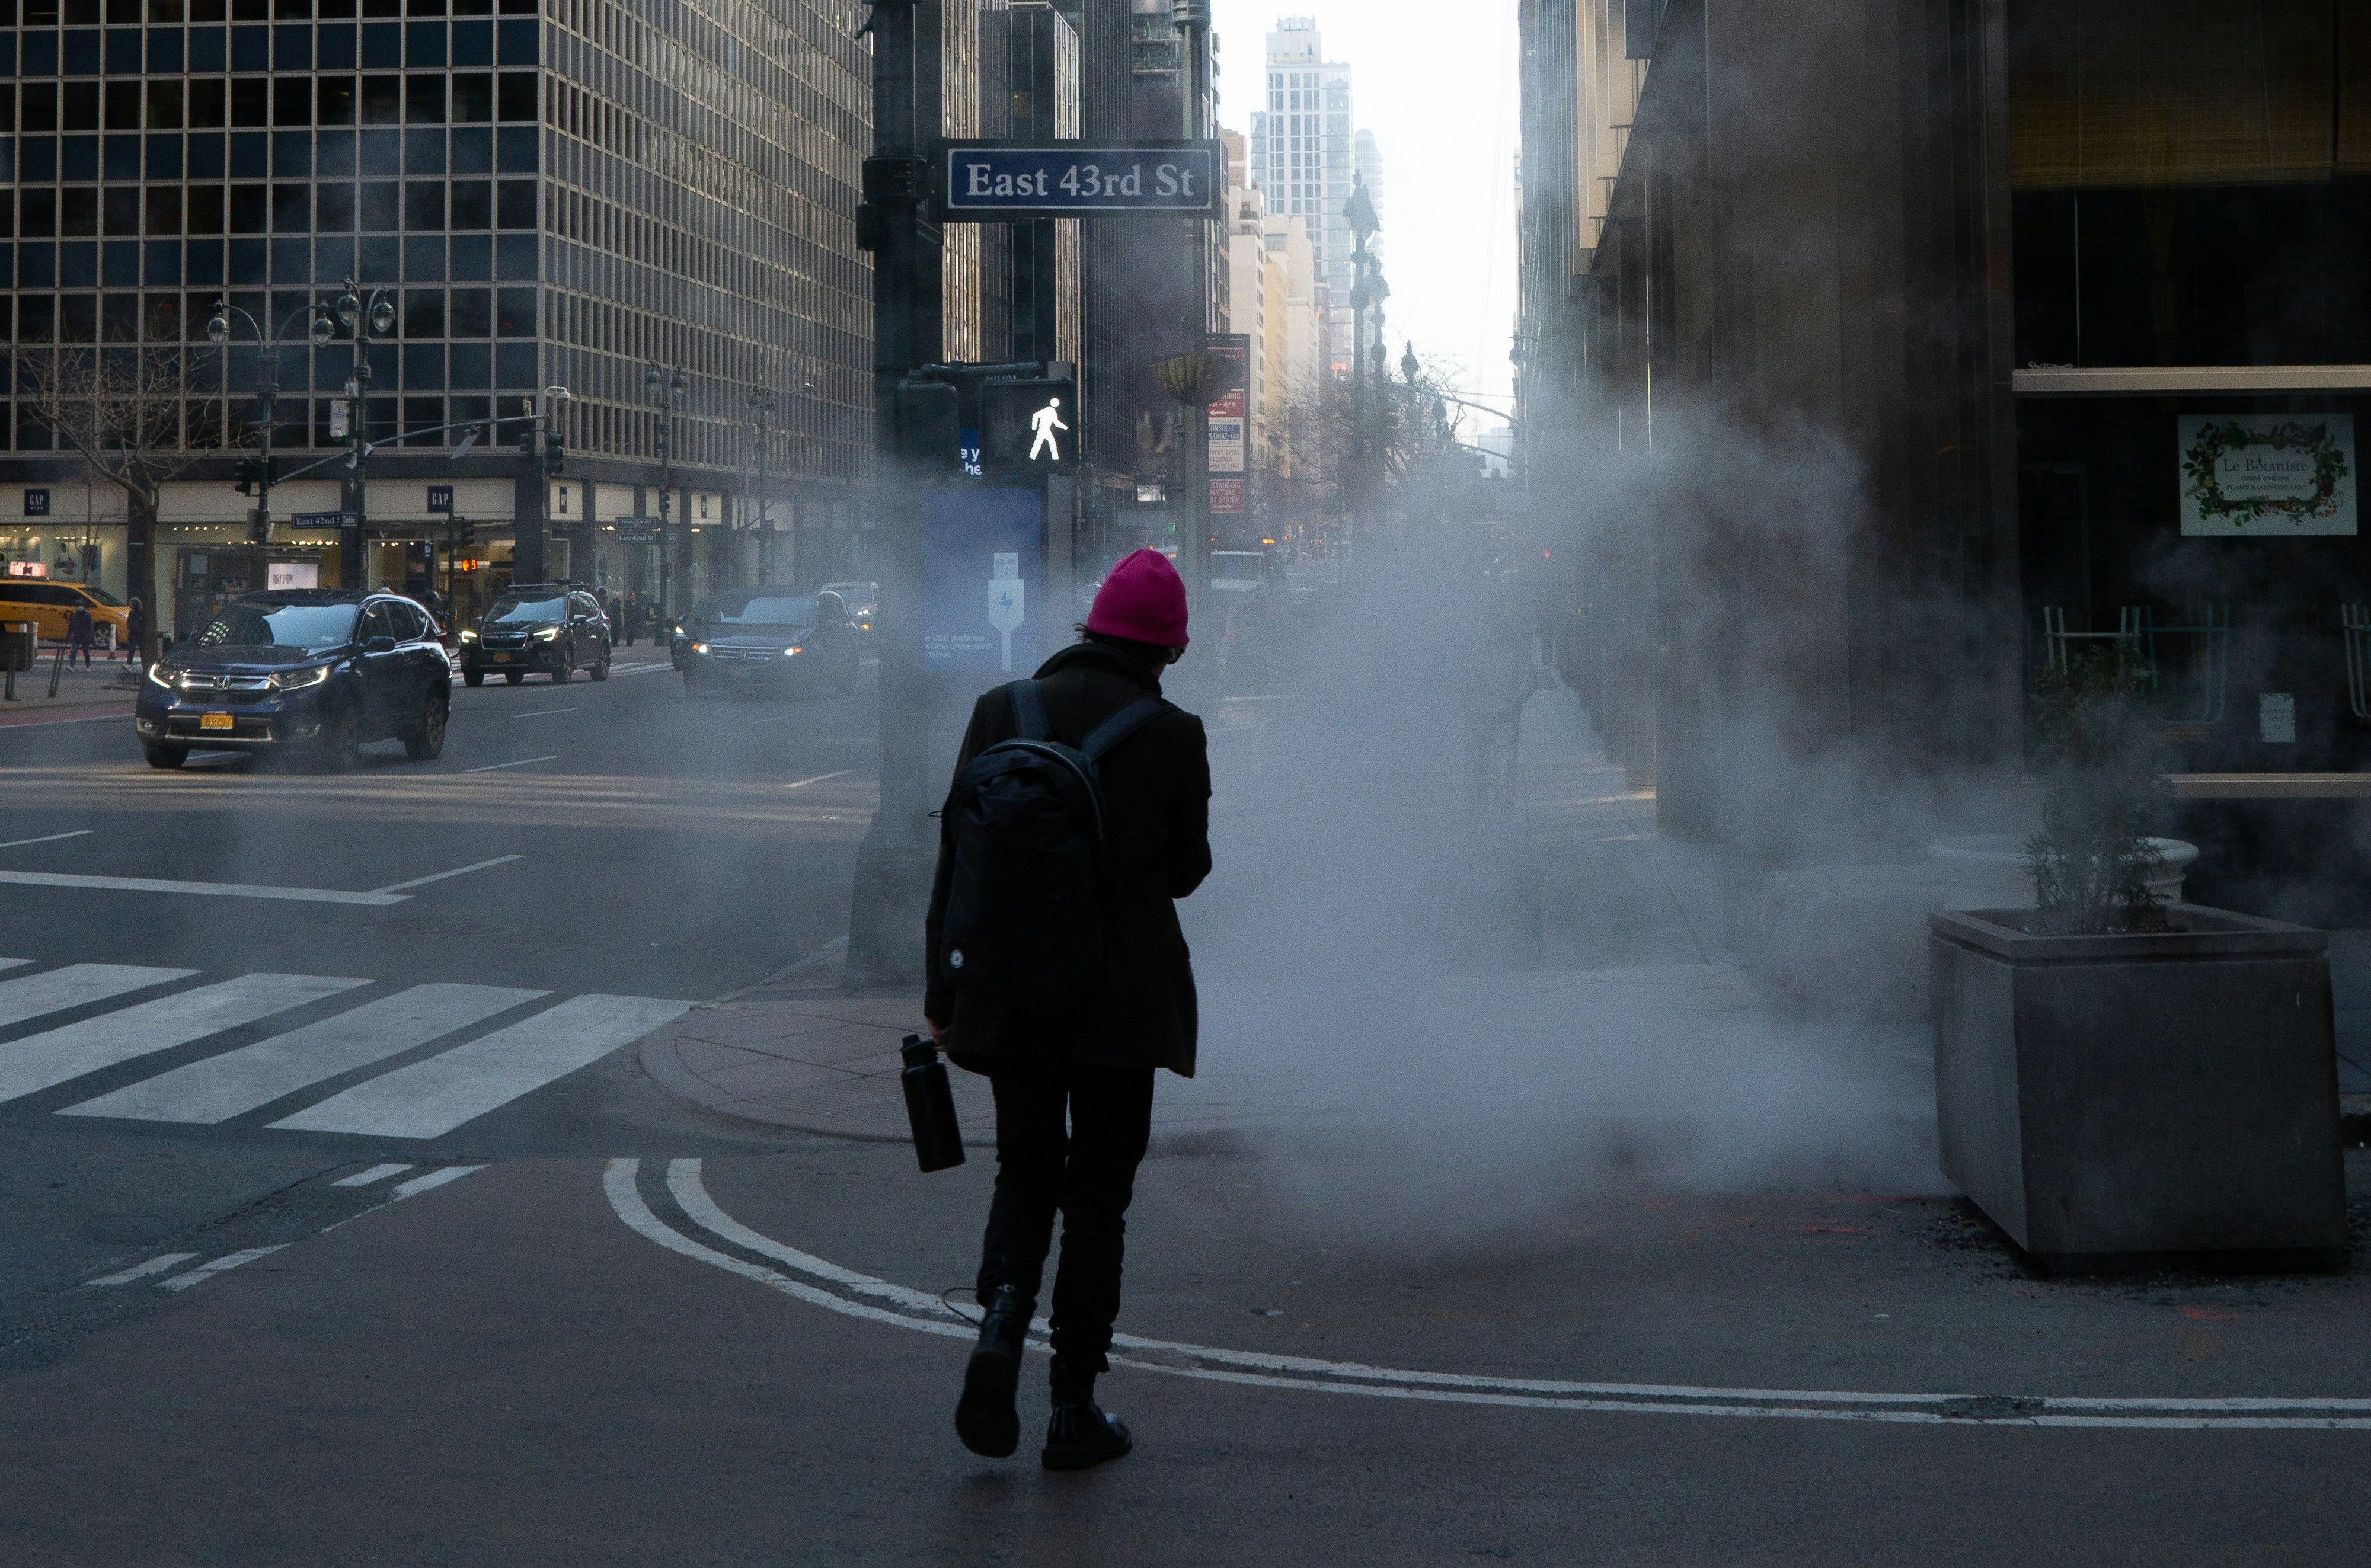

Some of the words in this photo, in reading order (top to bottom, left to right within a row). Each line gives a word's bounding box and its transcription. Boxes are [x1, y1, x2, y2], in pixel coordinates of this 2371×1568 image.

[966, 164, 1048, 196] East
[1060, 164, 1142, 197] 43rd
[1155, 164, 1194, 197] St
[2223, 459, 2240, 472] Le
[30, 494, 44, 505] GAP
[432, 492, 449, 505] GAP
[296, 517, 314, 526] East
[315, 516, 335, 525] 42nd
